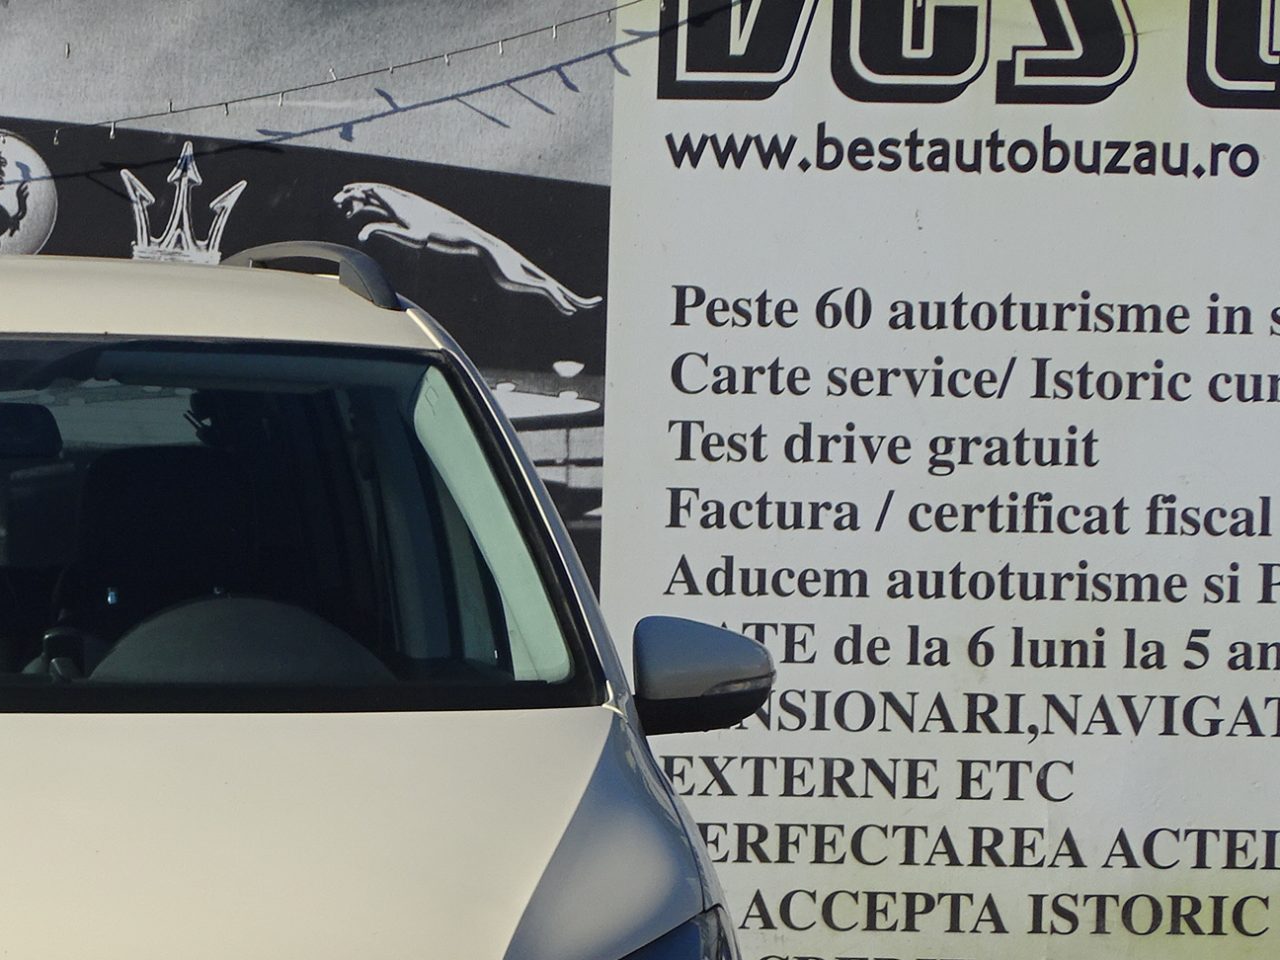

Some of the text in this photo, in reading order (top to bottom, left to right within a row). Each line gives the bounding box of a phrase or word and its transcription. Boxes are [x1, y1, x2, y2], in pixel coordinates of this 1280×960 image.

[665, 121, 1260, 179] www.bestautobuzau.ro
[670, 284, 799, 329] Peste
[815, 287, 872, 330] 60
[888, 290, 1191, 334] autoturisme
[1206, 292, 1253, 335] in
[670, 352, 811, 396] Carte
[826, 355, 1017, 400] service/
[1030, 357, 1192, 402] Istoric
[668, 420, 1100, 477] Test drive gratuit
[665, 487, 1272, 537] Factura / certificat fiscal
[663, 554, 869, 598] Aducem
[886, 559, 1189, 604] autoturisme
[1203, 561, 1241, 604] si
[721, 621, 1280, 671] TE de la 6 luni la 5 an
[658, 755, 1074, 803] EXTERNE ETC
[696, 822, 1087, 869] ERFECTAREA
[738, 888, 1270, 938] ACCEPTA ISTORIC
